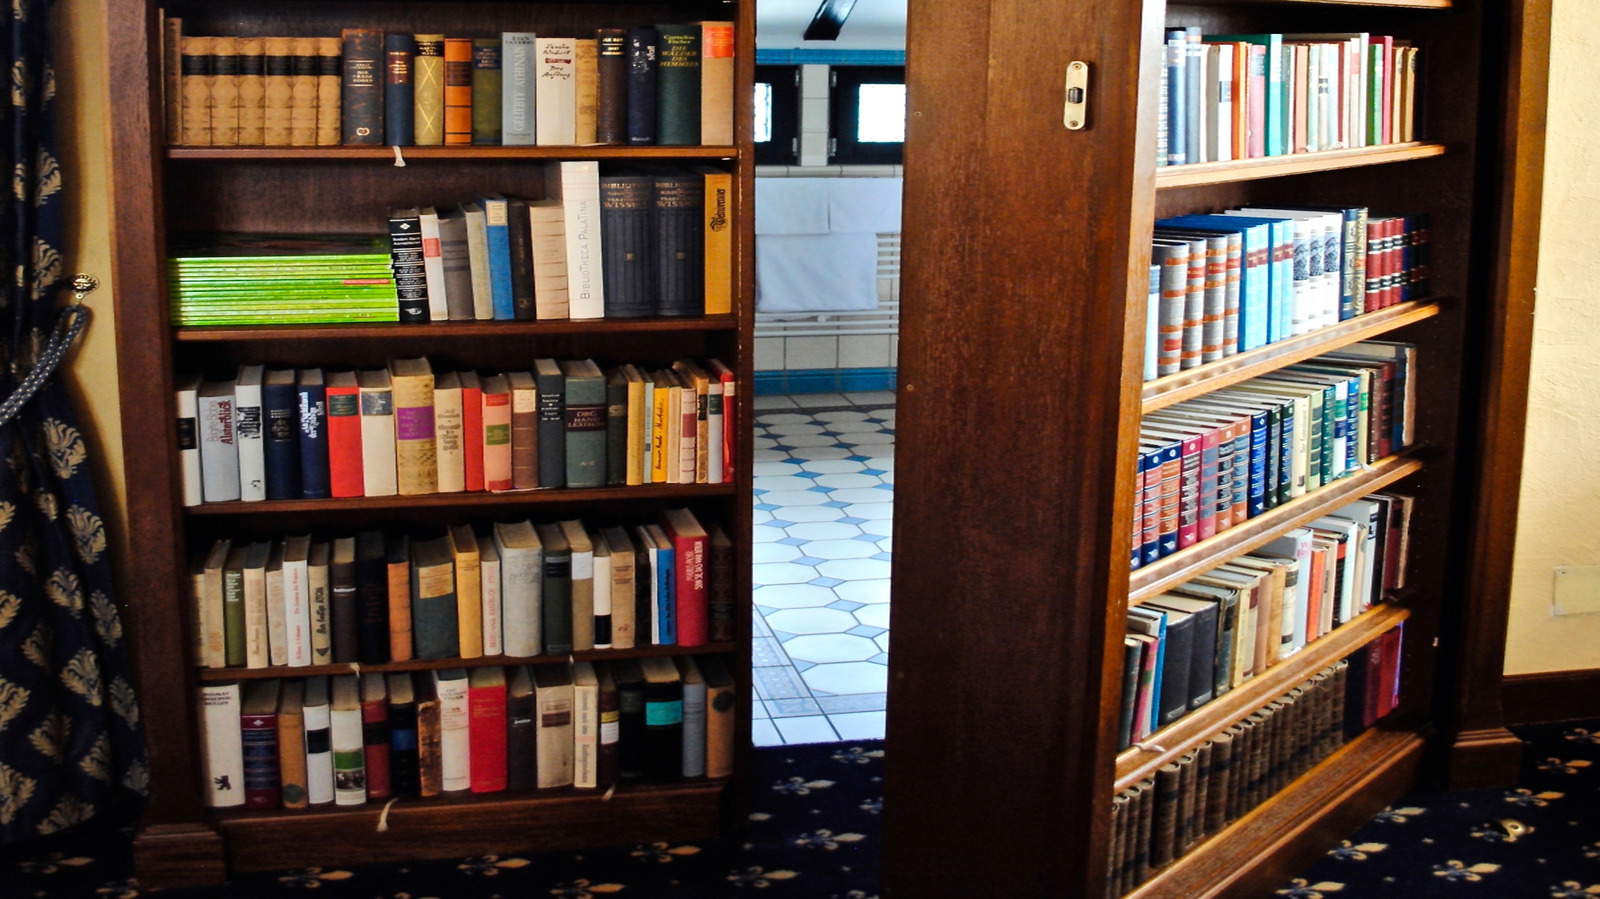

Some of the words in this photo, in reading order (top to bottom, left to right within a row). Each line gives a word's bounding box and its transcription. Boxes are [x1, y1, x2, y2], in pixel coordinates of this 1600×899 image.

[513, 90, 526, 131] GELIEBTE
[577, 200, 589, 241] PALATINA
[579, 244, 591, 300] BIBLIOTHECA
[217, 400, 233, 445] Alsterblick
